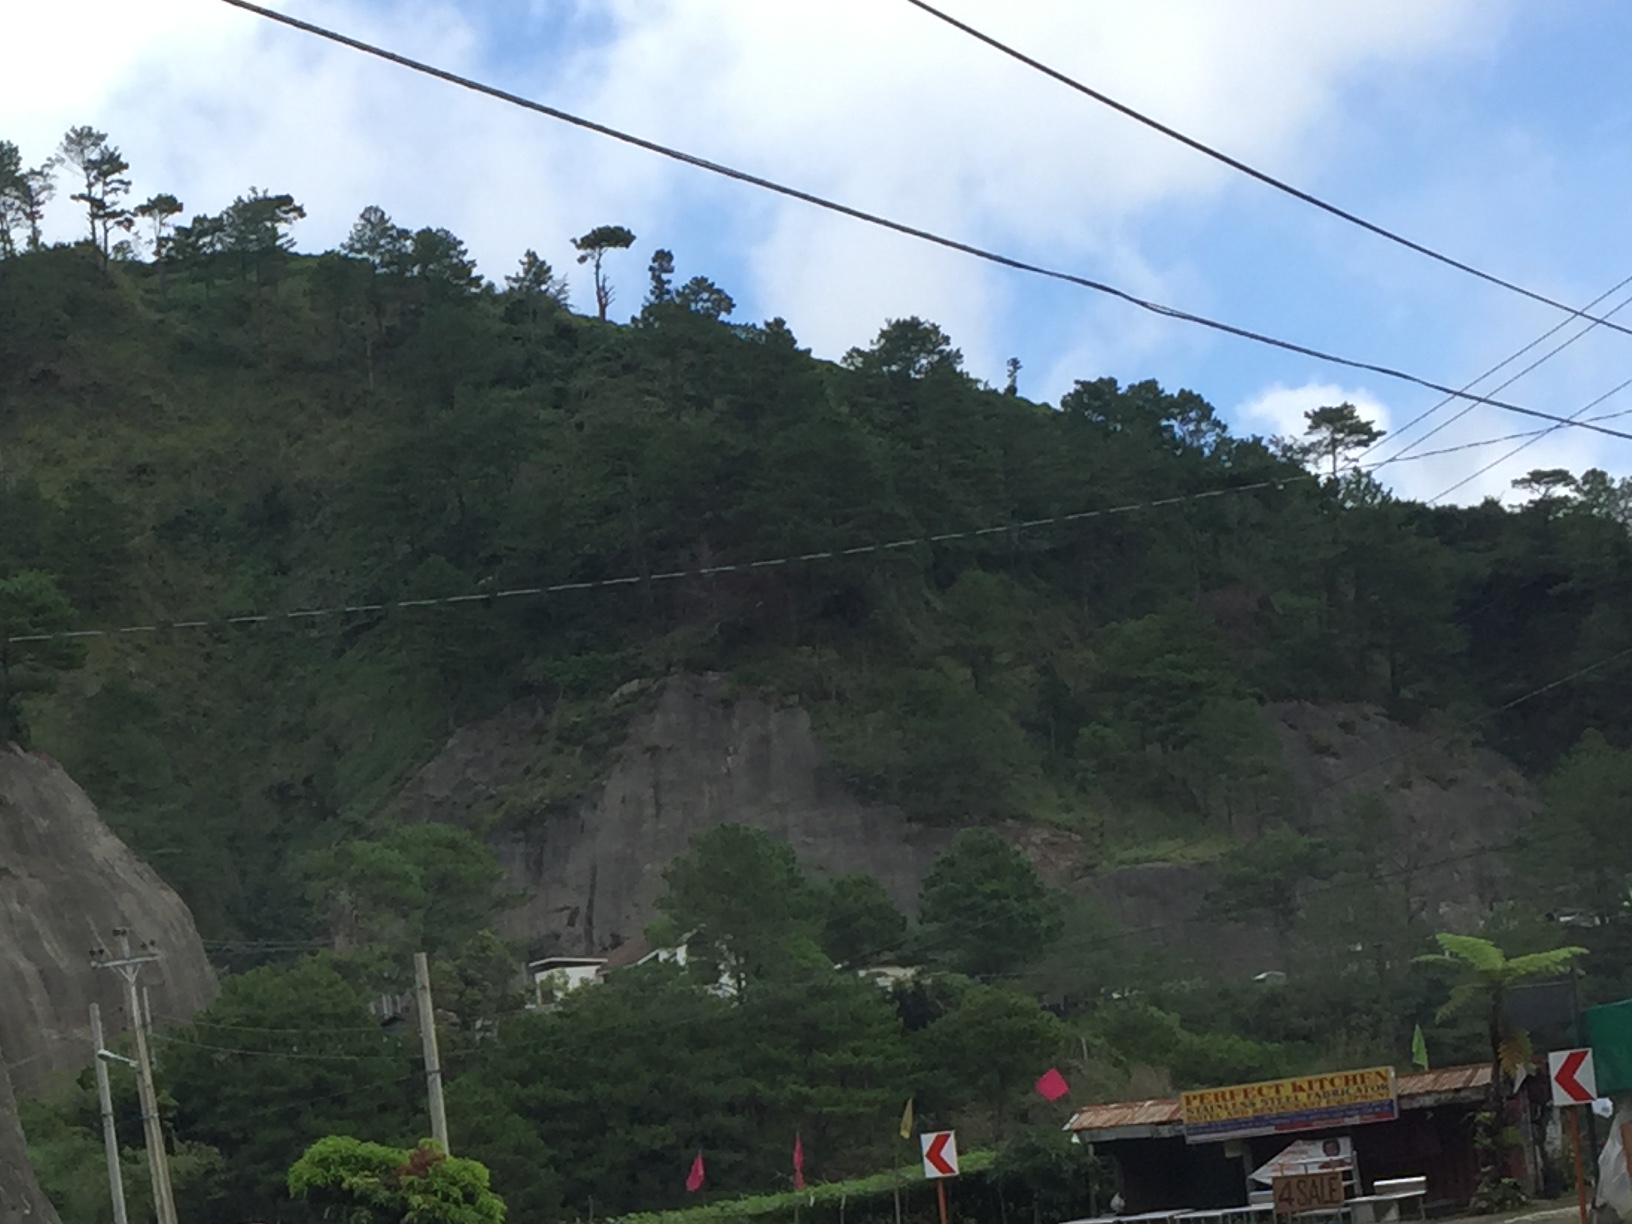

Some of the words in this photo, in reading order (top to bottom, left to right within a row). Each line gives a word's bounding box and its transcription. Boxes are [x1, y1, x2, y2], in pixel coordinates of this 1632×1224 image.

[1184, 1083, 1284, 1107] PERFECT
[1290, 1070, 1388, 1093] KITCHEN
[1185, 1099, 1256, 1115] STAINLESS
[1260, 1093, 1299, 1106] STEEL
